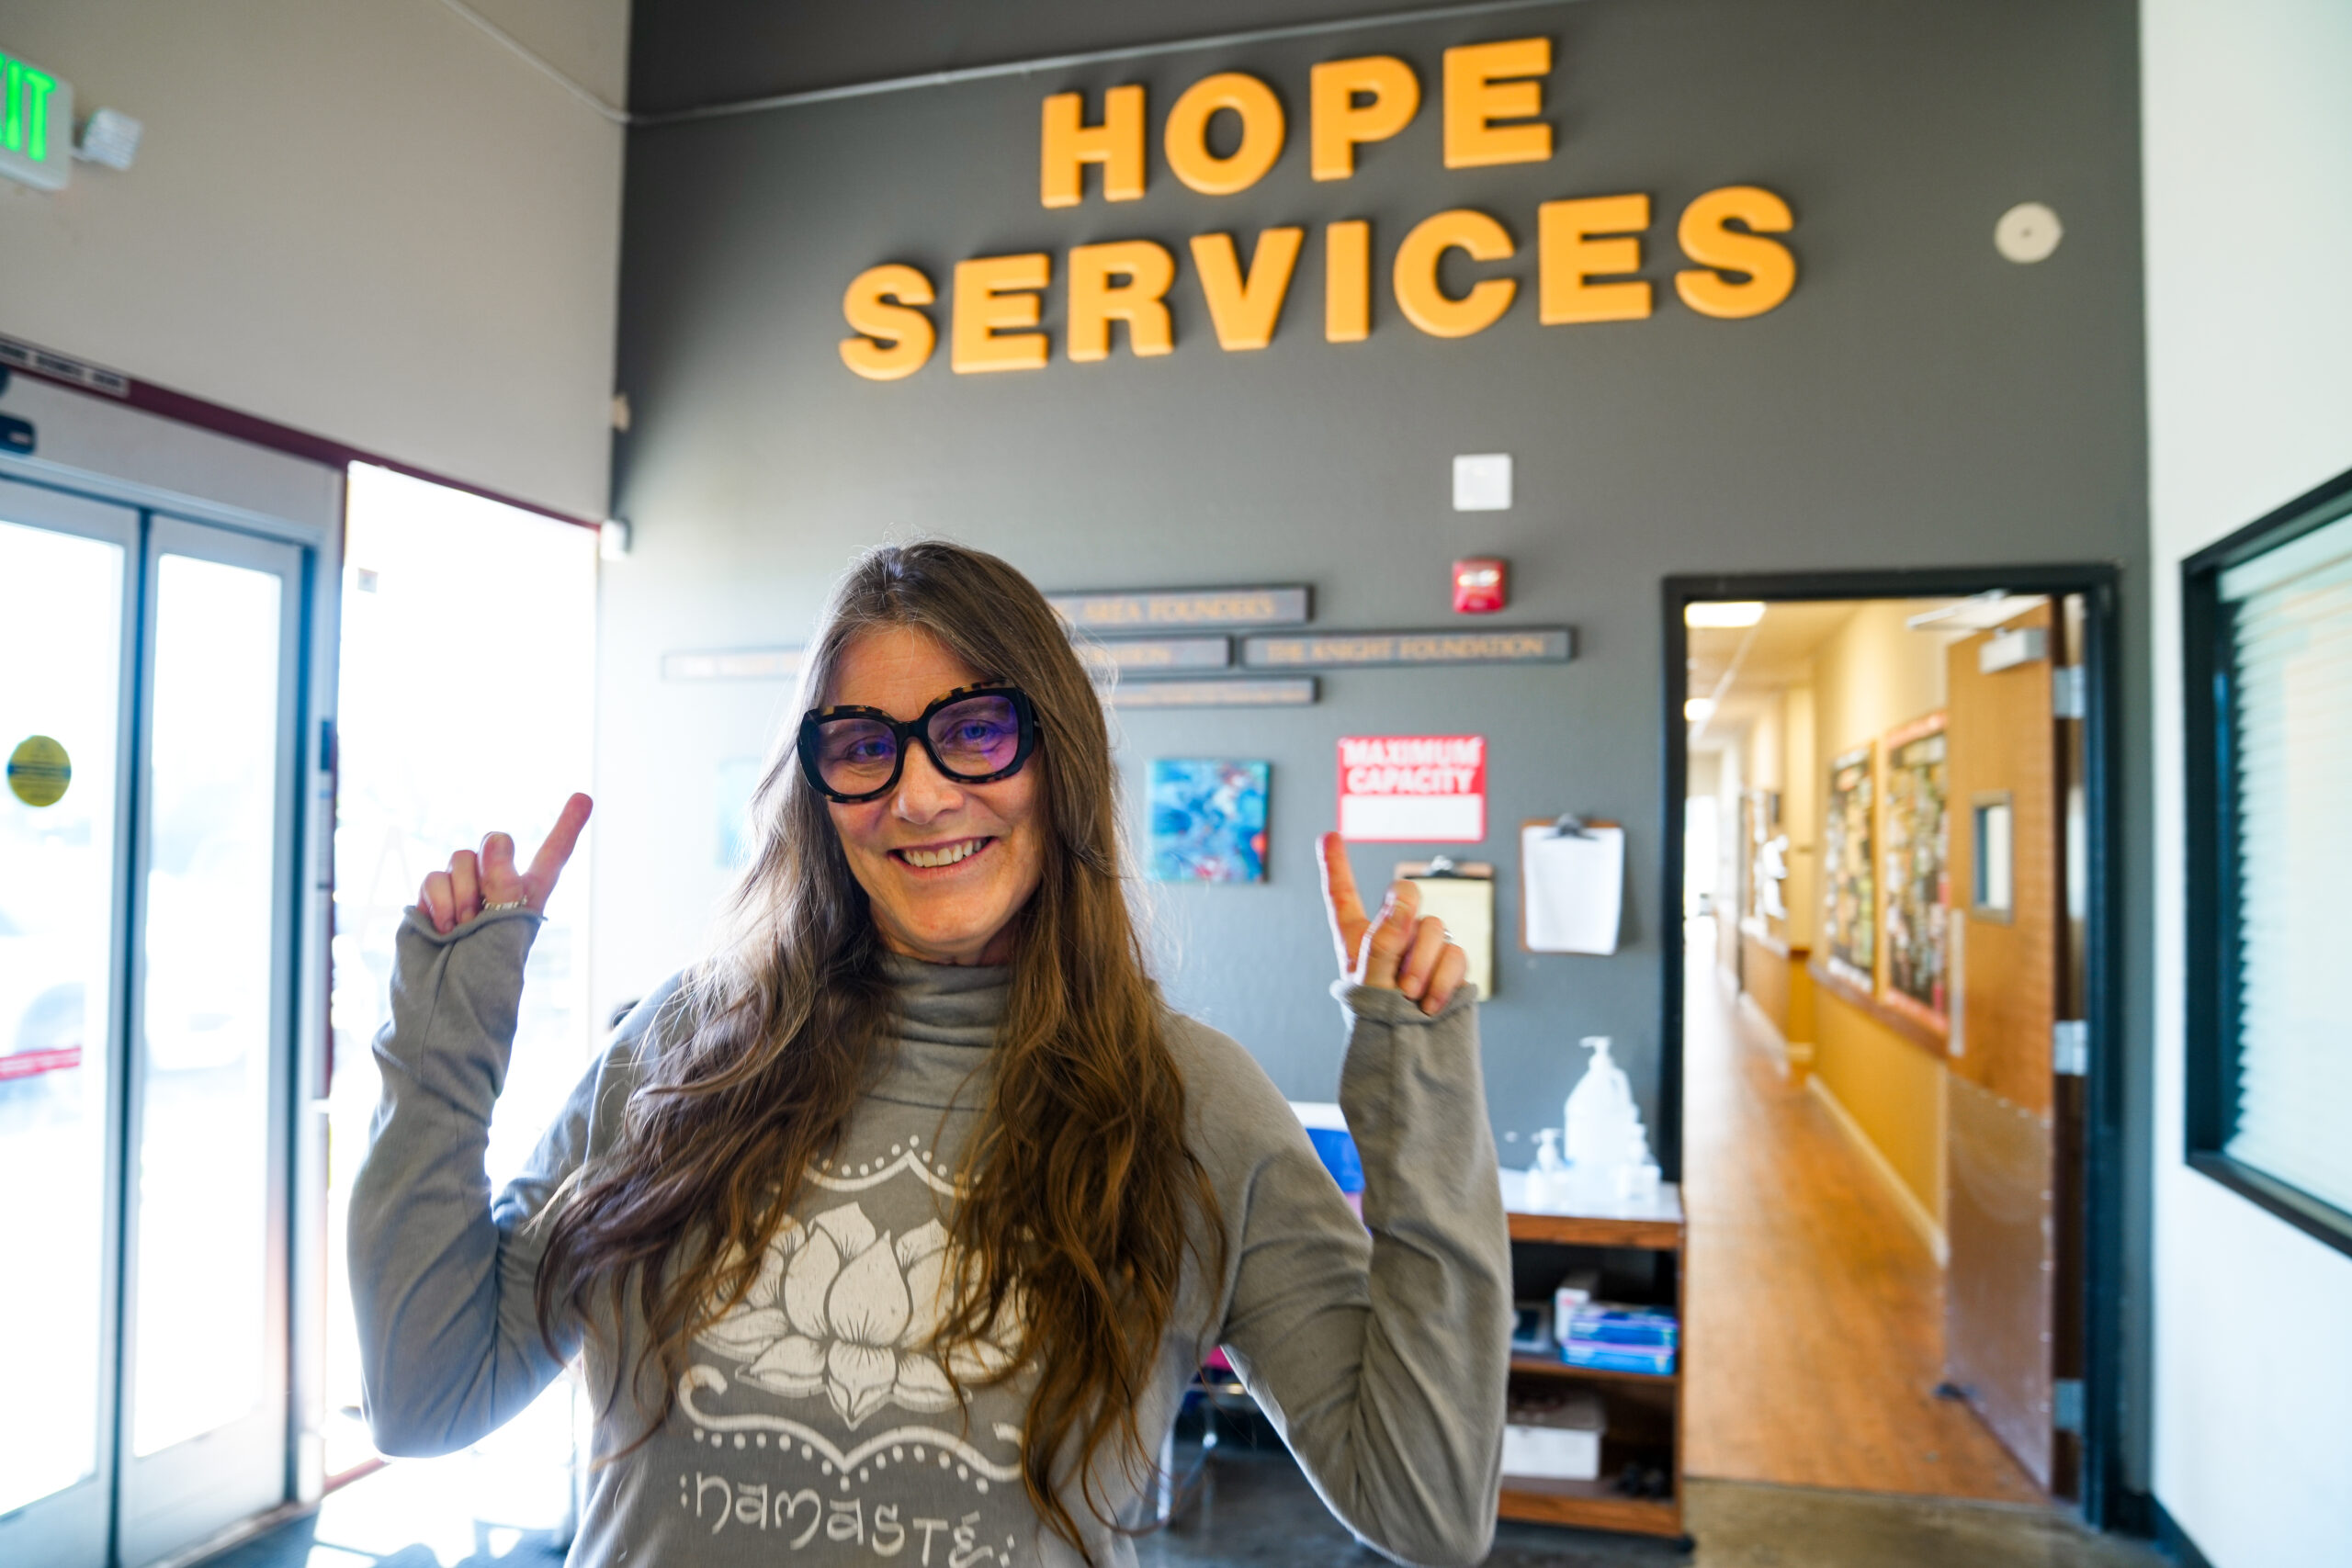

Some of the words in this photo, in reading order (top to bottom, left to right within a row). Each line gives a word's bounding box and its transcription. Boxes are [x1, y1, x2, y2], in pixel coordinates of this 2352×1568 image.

[0, 52, 57, 163] IT
[1041, 37, 1553, 209] HOPE
[838, 186, 1797, 382] SERVICES
[1342, 739, 1482, 767] MAXIMUM
[1346, 767, 1476, 795] CAPACITY
